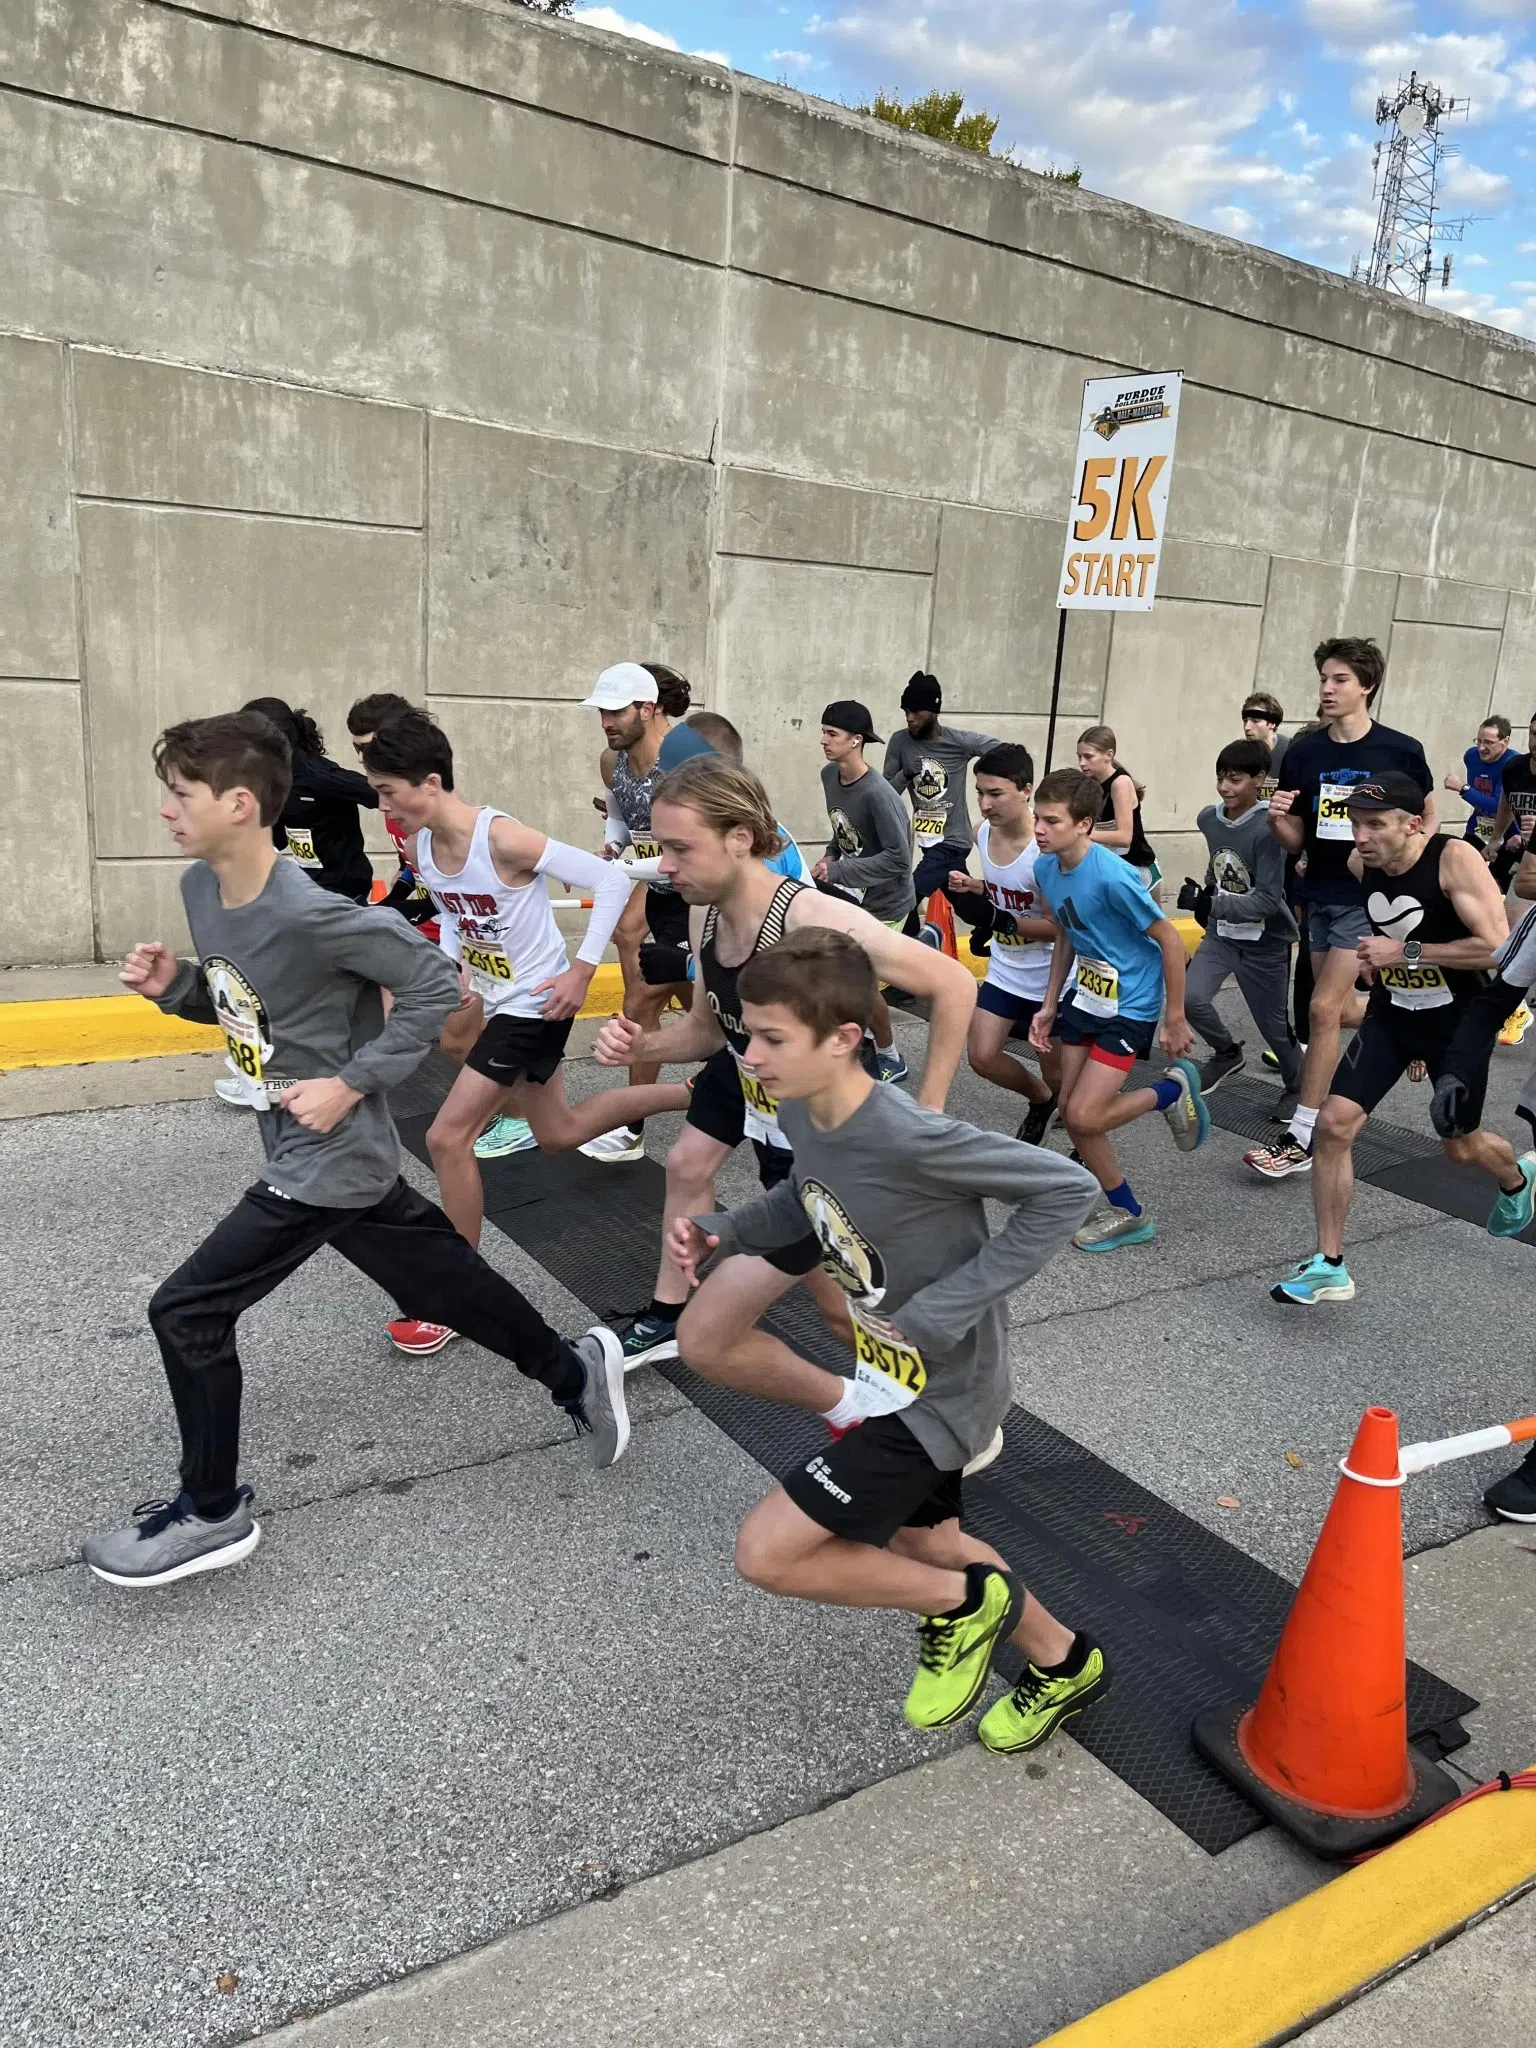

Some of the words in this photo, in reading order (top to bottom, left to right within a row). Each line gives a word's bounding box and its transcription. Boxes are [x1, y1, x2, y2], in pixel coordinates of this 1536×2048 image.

[1114, 395, 1163, 408] BOILERMAKER
[1116, 385, 1166, 402] PURDUE
[1073, 455, 1168, 541] 5K
[1063, 553, 1156, 597] START
[1320, 798, 1350, 819] 34
[915, 818, 943, 834] 2276
[462, 945, 511, 979] 2315
[1080, 966, 1114, 998] 2337
[1381, 967, 1441, 989] 2959
[813, 1470, 852, 1504] SPORTS
